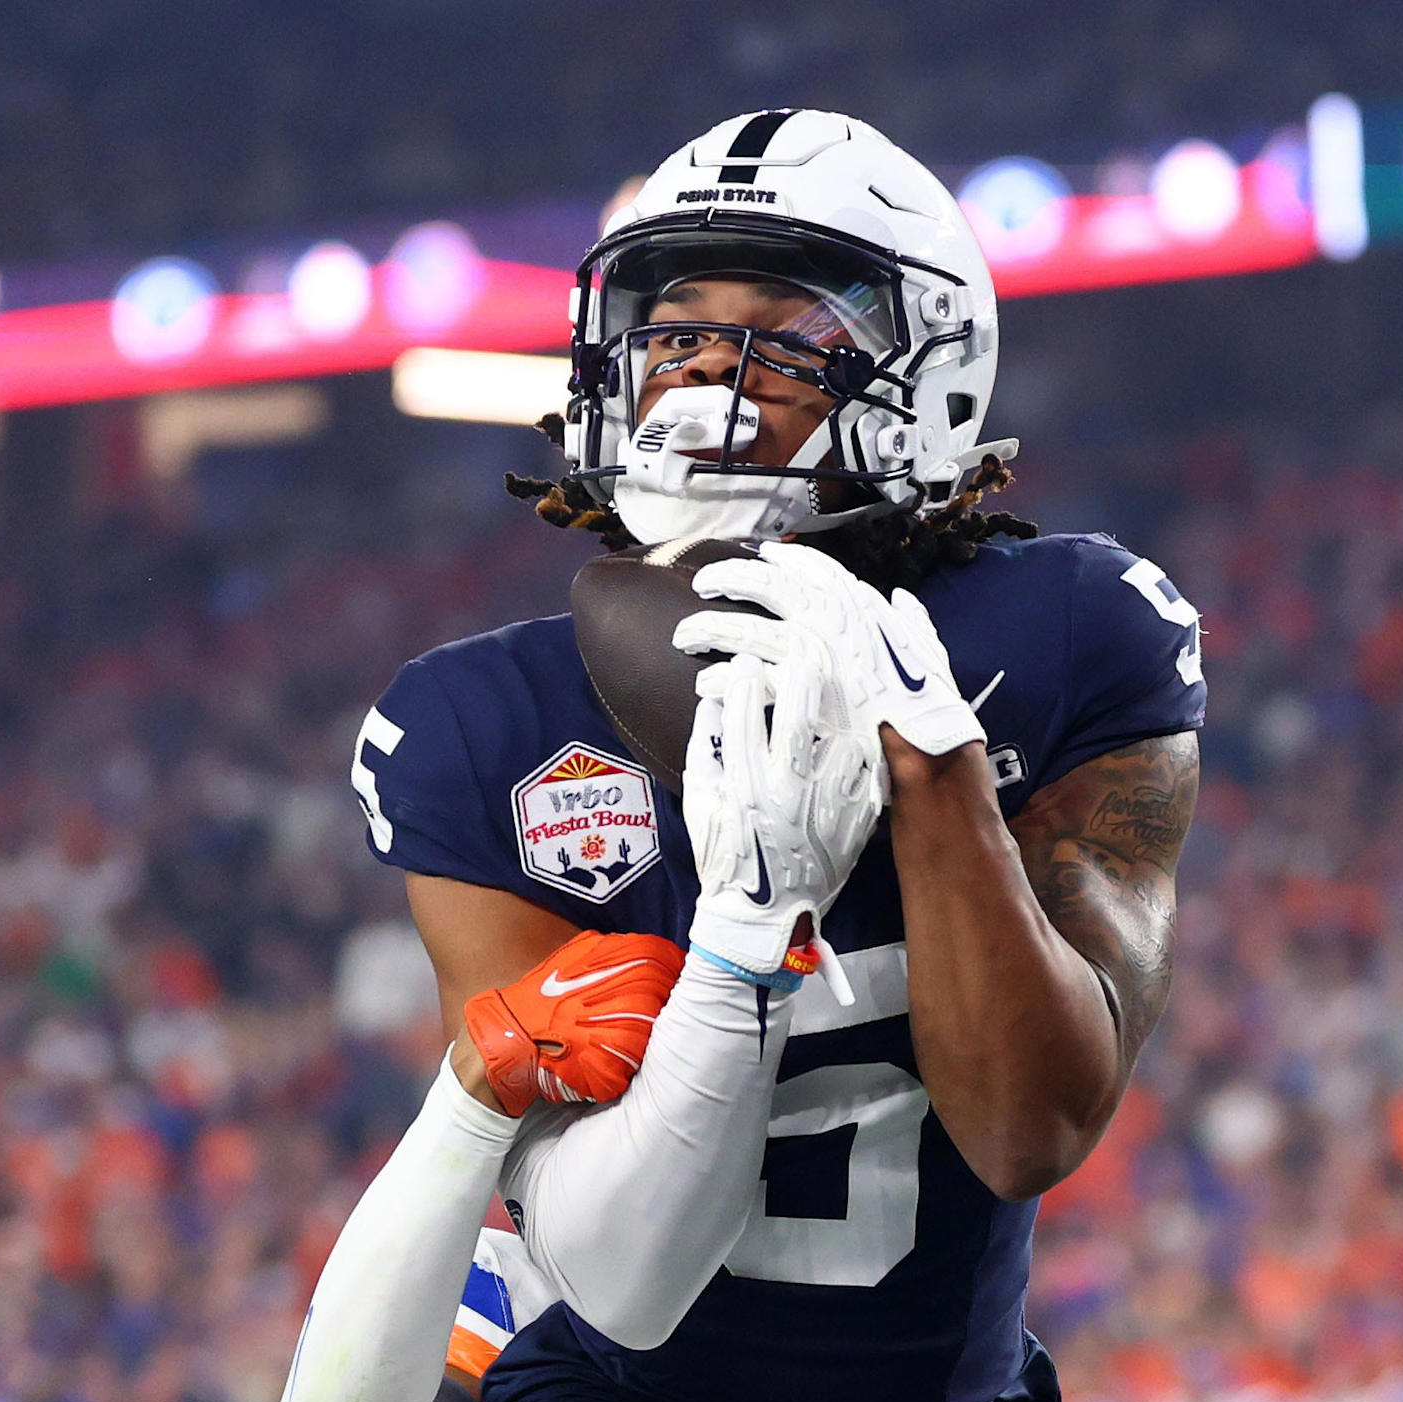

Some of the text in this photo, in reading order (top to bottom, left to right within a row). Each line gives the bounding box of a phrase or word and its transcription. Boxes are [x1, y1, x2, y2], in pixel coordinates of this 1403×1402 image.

[676, 188, 778, 204] PENN STATE
[350, 705, 406, 854] 5
[547, 783, 624, 814] Vrbo
[525, 810, 653, 845] Fiesta Bowl
